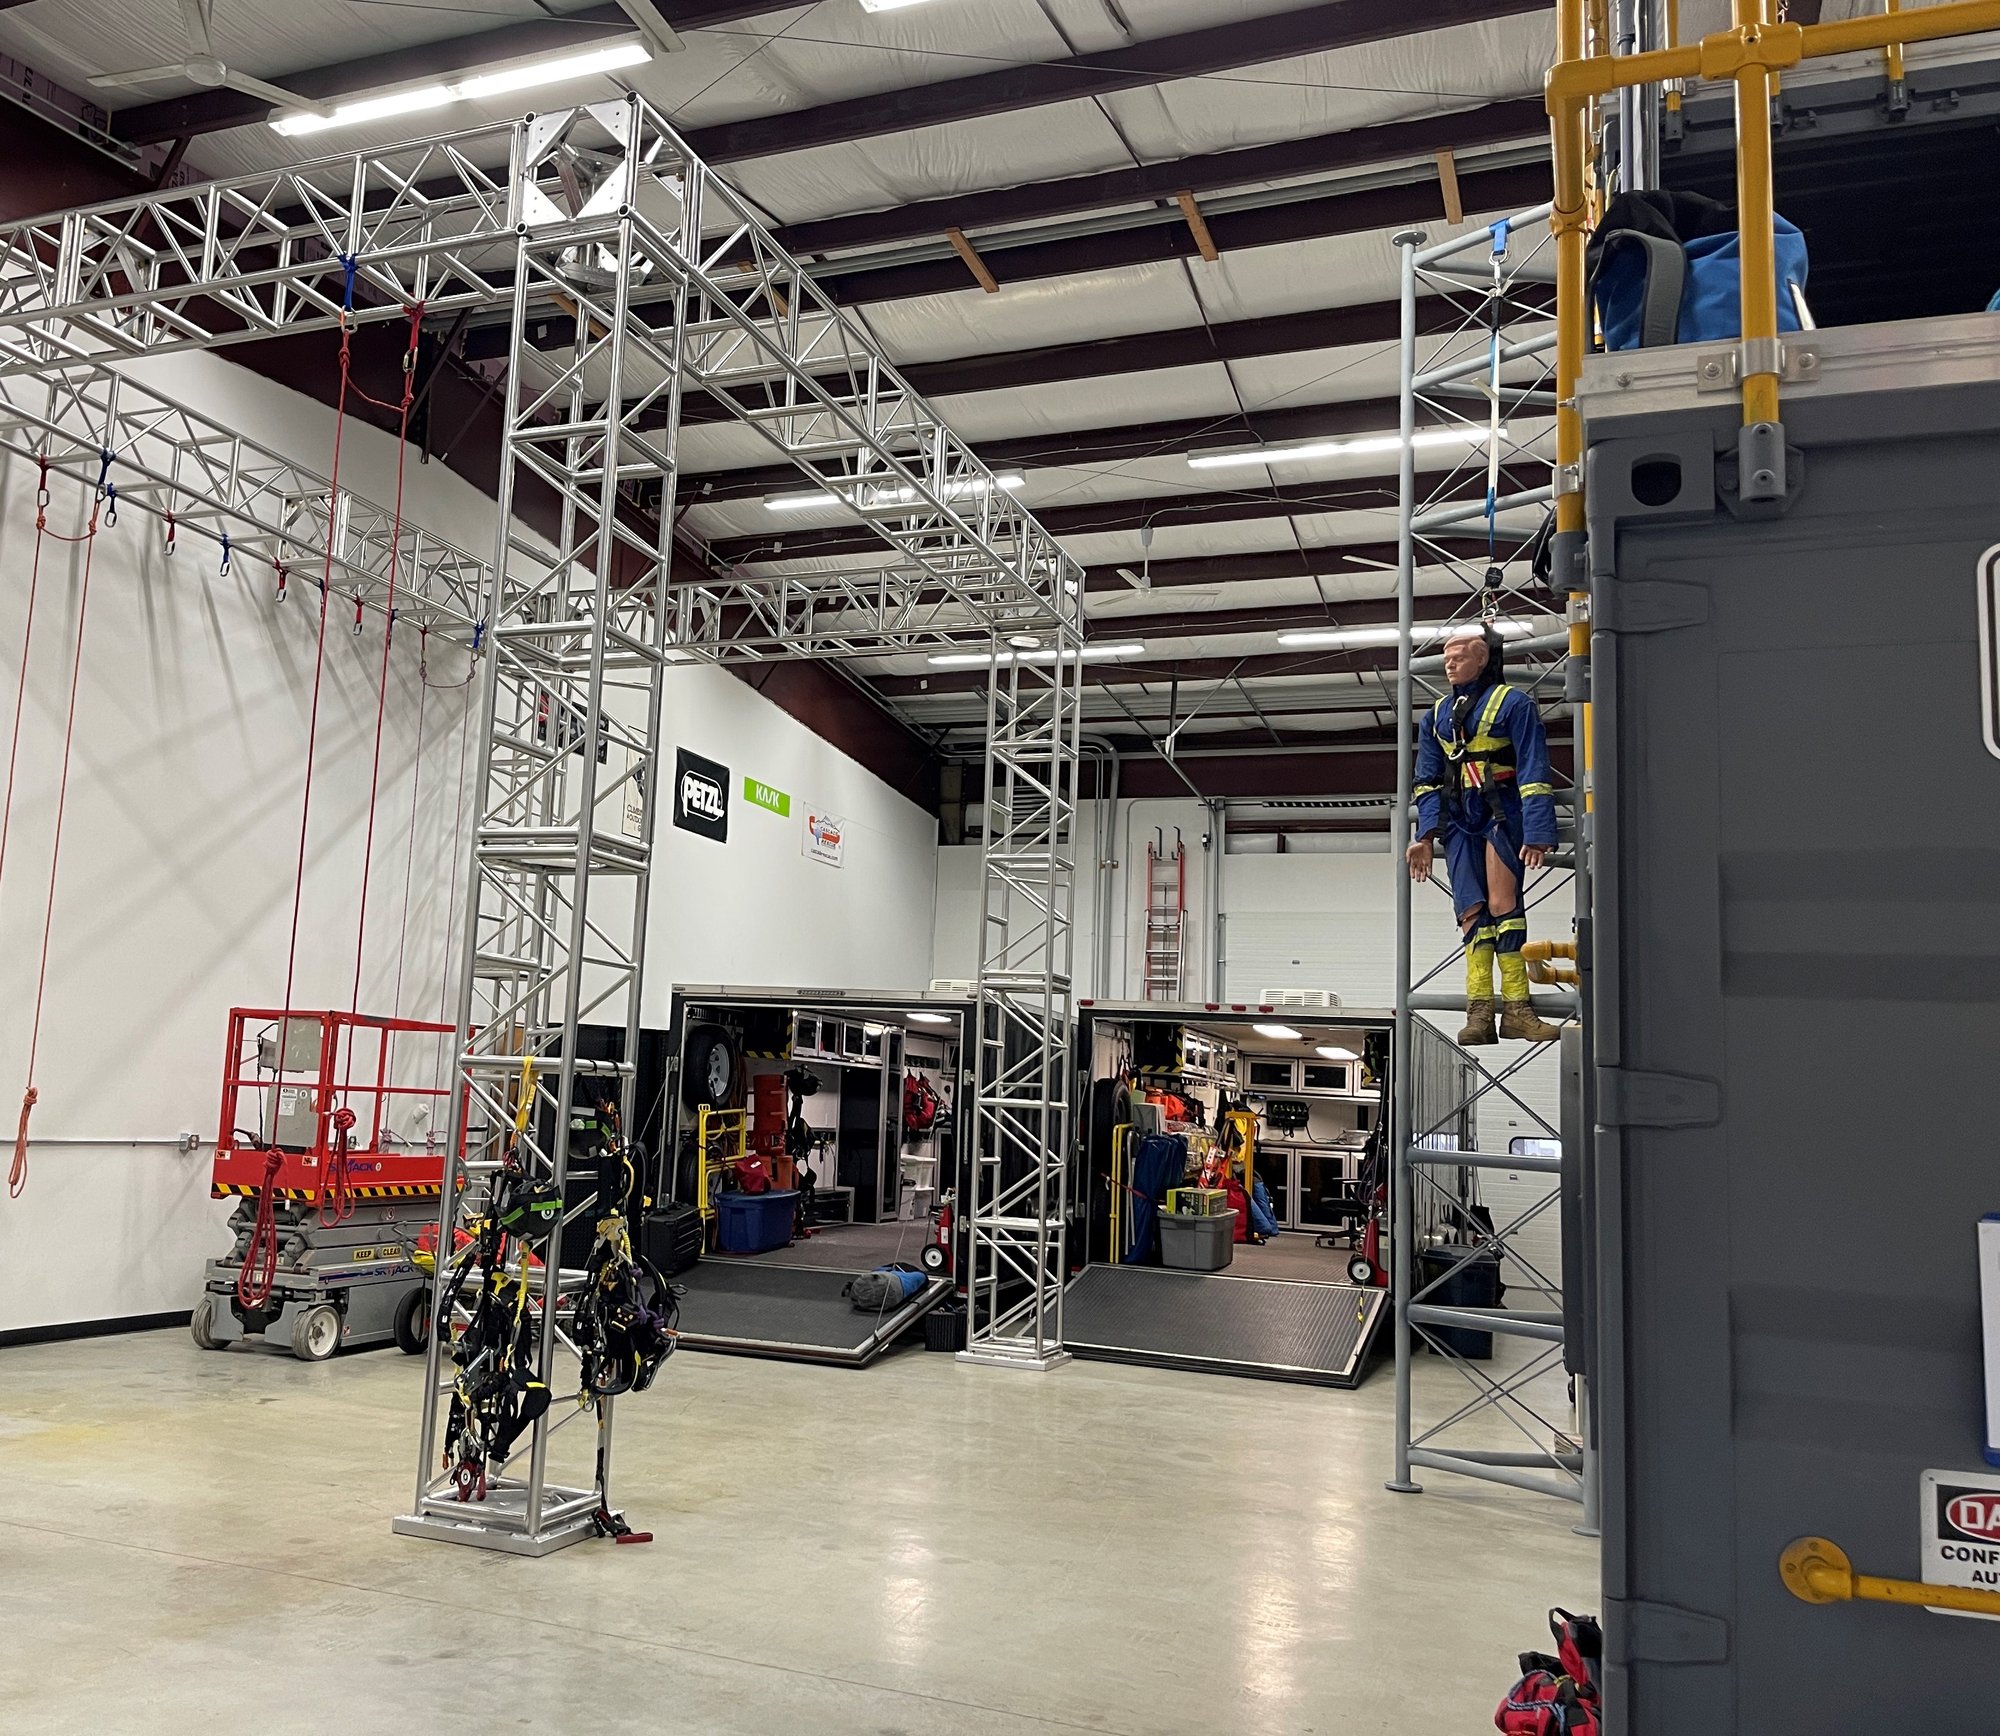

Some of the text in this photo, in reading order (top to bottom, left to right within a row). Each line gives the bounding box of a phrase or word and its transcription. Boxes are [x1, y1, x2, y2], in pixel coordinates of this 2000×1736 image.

[683, 775, 725, 818] PETZL
[355, 1250, 372, 1259] KEEP
[1941, 1545, 2000, 1565] CONF
[1972, 1569, 2000, 1585] AU
